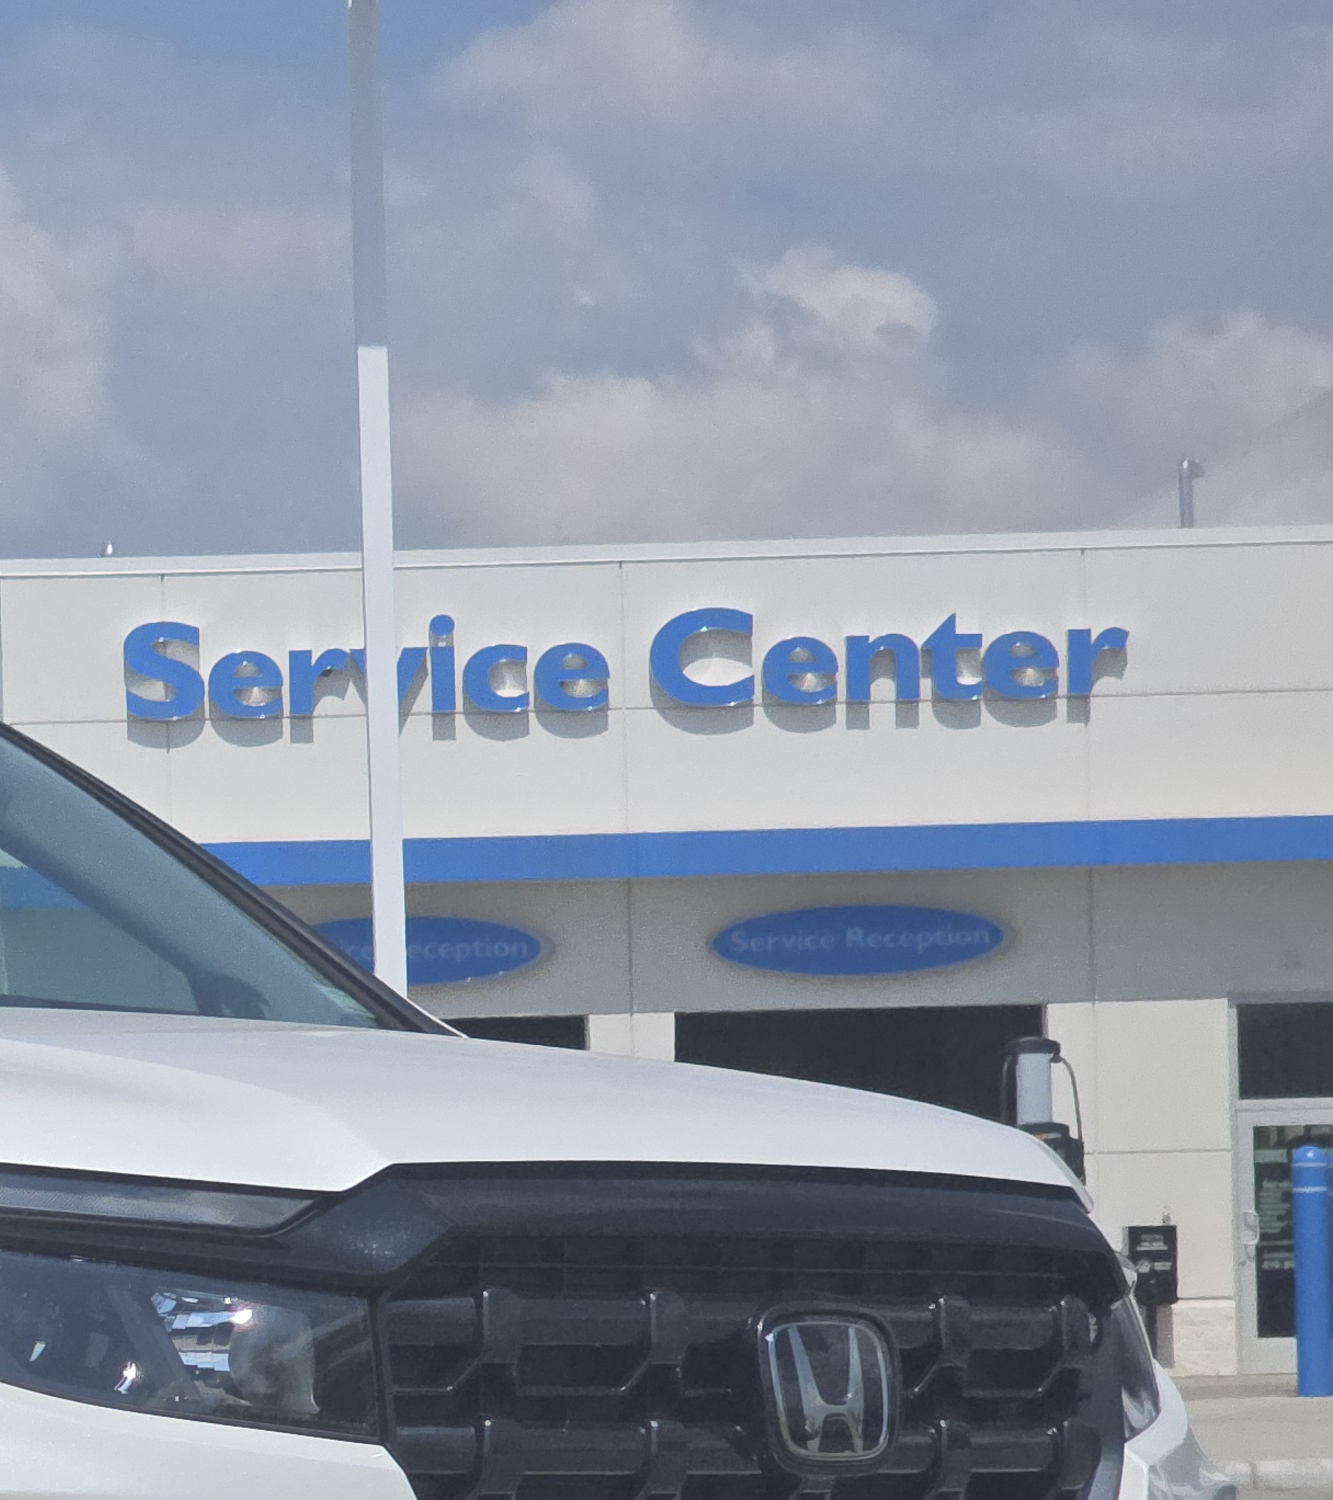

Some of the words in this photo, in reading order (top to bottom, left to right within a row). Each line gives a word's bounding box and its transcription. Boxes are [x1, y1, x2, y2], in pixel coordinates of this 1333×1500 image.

[650, 607, 1130, 705] Center
[406, 936, 527, 962] eception
[731, 929, 835, 953] Service
[846, 925, 990, 954] Reception
